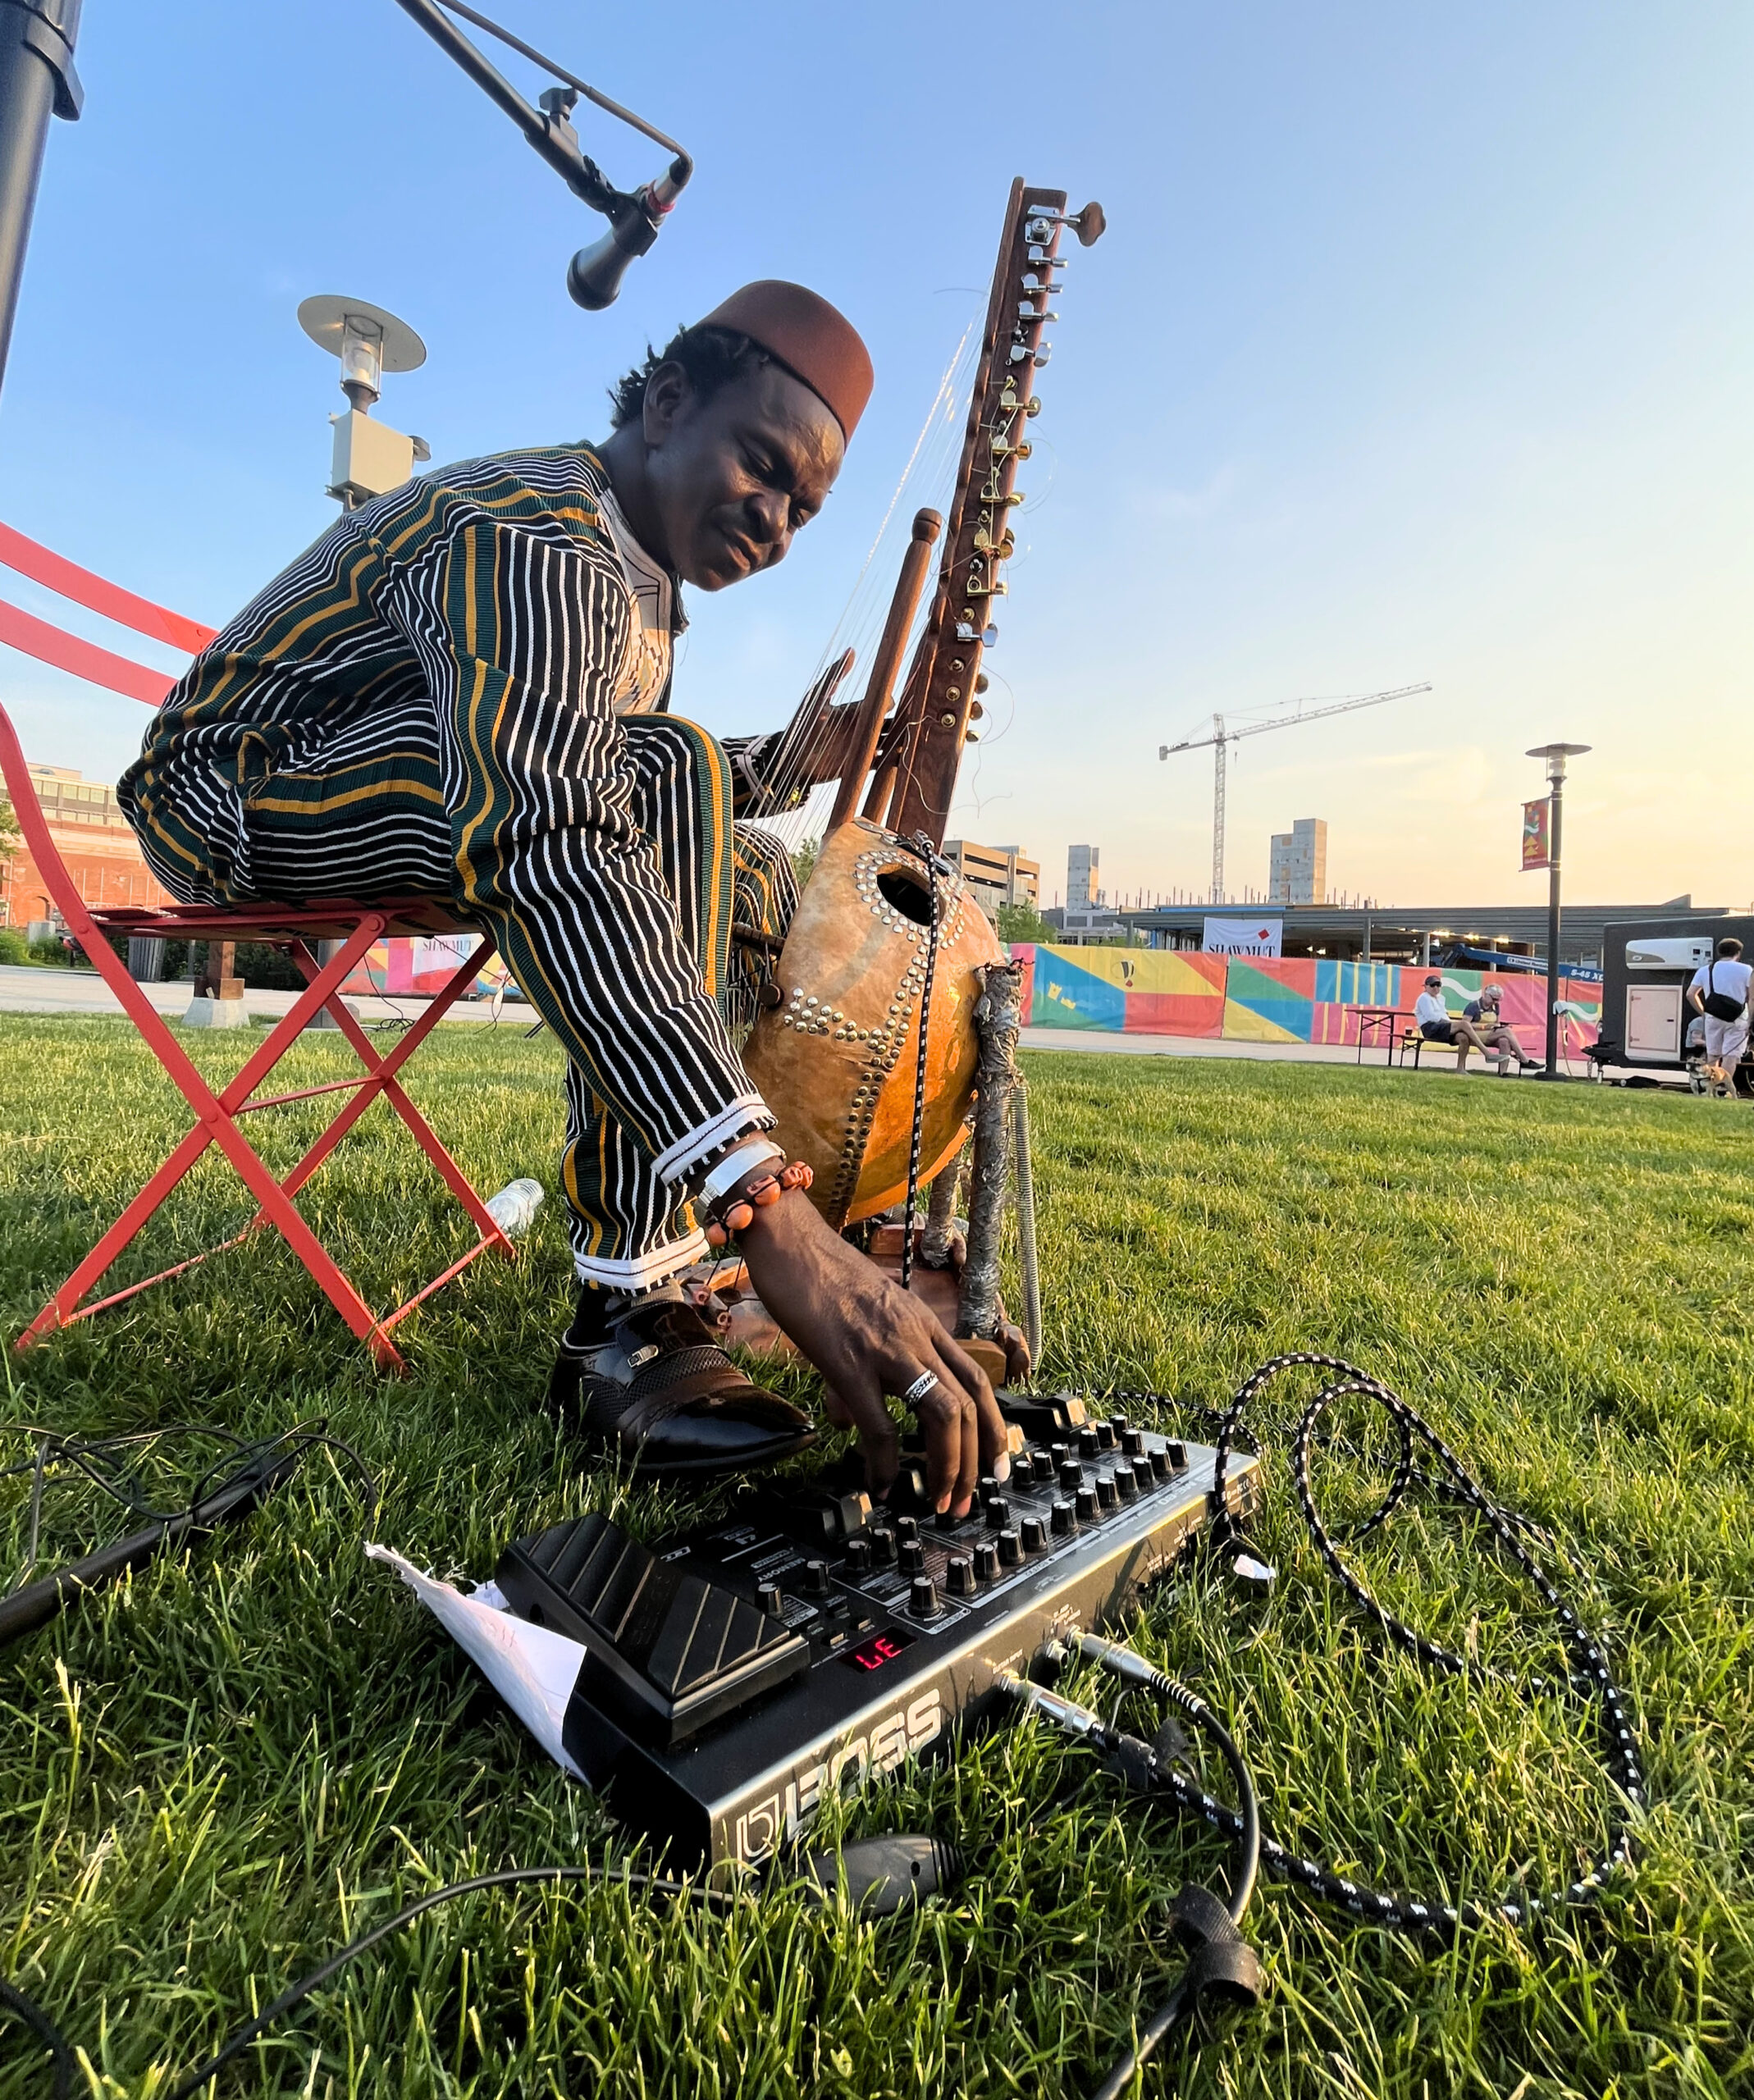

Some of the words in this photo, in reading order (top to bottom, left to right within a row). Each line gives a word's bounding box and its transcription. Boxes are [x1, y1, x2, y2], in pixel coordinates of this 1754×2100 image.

[423, 940, 473, 952] SHAWMUT
[1570, 969, 1591, 979] S-45
[757, 1557, 806, 1582] MEMORY
[785, 1688, 942, 1843] BOSS
